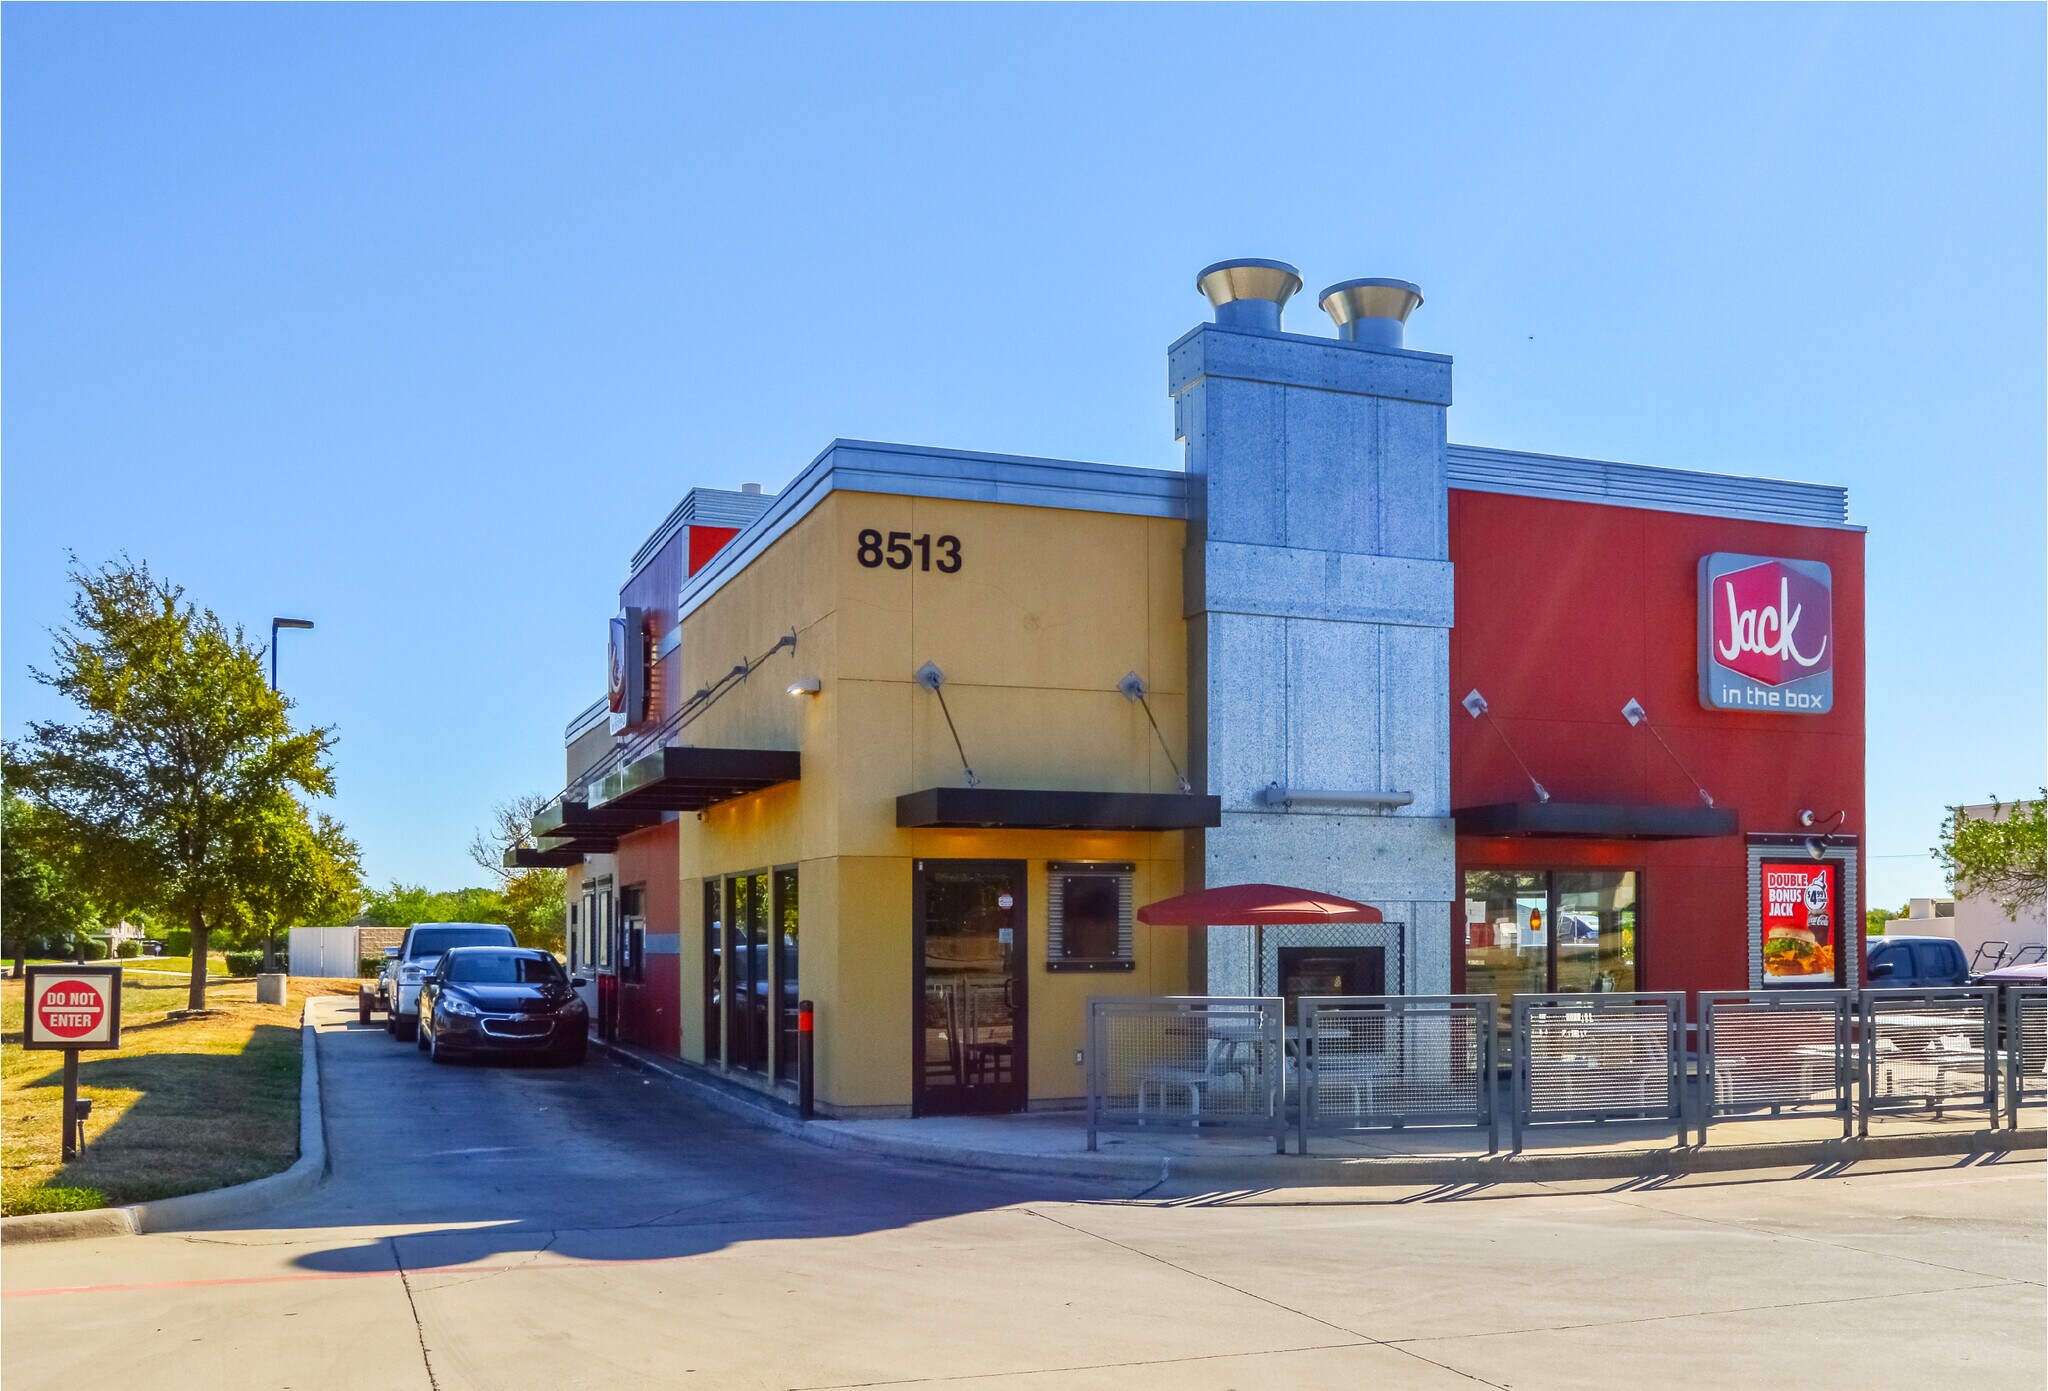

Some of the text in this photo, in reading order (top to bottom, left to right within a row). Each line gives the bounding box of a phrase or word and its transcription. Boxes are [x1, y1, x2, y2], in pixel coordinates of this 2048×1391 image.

[857, 529, 962, 573] 8513
[1719, 577, 1827, 666] Jack
[1722, 685, 1822, 708] in the box
[1768, 873, 1807, 887] DOUBLE
[1769, 889, 1801, 902] BONUS
[1769, 903, 1793, 916] JACK
[47, 992, 96, 1005] DO NOT
[50, 1014, 91, 1027] ENTER
